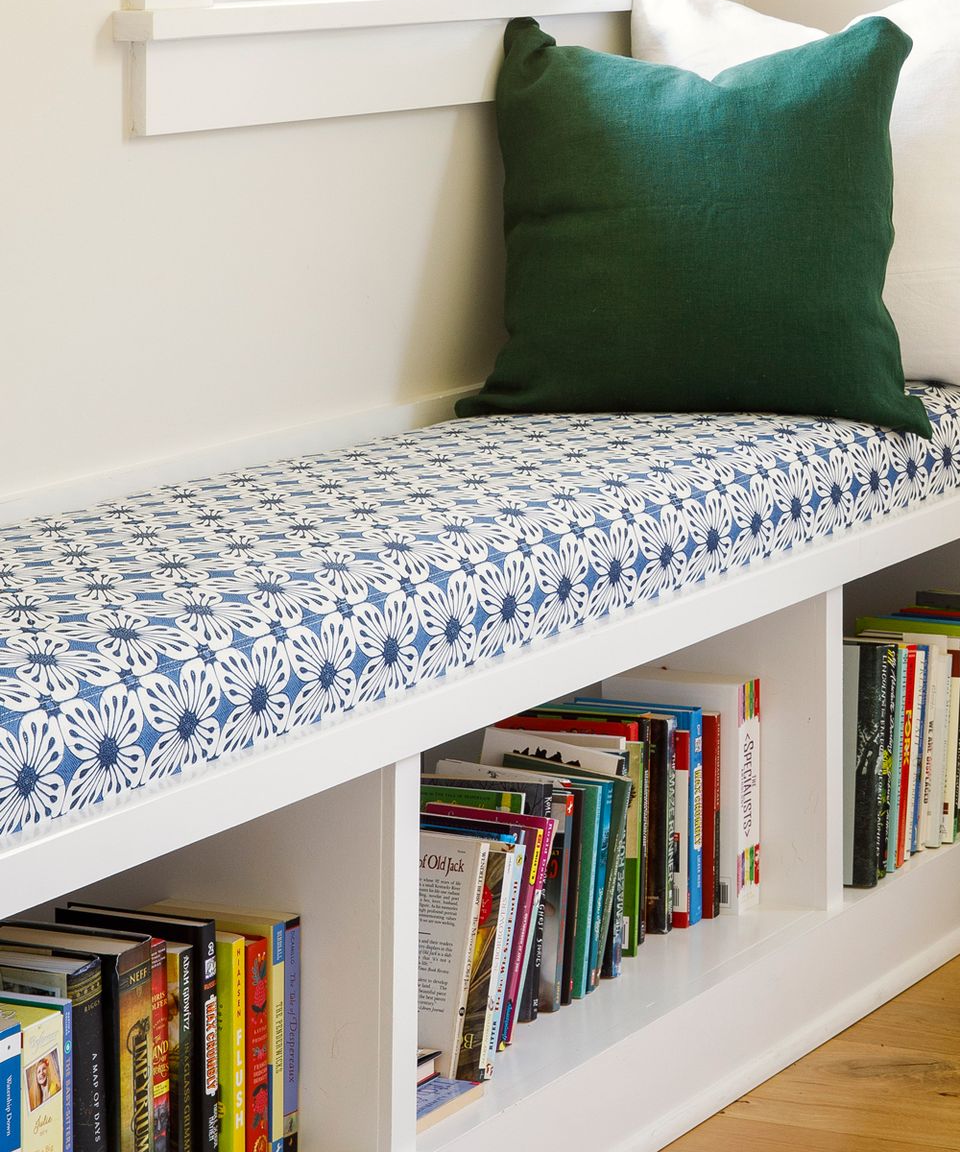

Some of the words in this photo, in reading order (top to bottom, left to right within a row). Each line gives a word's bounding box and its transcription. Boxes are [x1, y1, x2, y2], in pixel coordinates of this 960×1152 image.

[903, 709, 912, 765] FORK
[928, 720, 934, 734] WE
[667, 774, 675, 818] MAZE
[924, 756, 932, 804] DISPLACED
[428, 854, 447, 870] Old
[445, 857, 464, 877] Jack
[477, 851, 487, 884] WENDELL
[474, 885, 482, 905] BERRY
[129, 967, 148, 985] NEFF
[183, 955, 191, 986] ADAM
[289, 972, 297, 989] The
[182, 988, 192, 1032] GIDWITZ
[206, 1003, 215, 1032] MAX
[206, 1034, 216, 1089] CRUMBLY
[275, 1020, 283, 1074] PENDERWICKS
[287, 1017, 297, 1083] Despereaux
[4, 1075, 13, 1112] Watership
[183, 1067, 191, 1103] GLASS
[235, 1029, 244, 1129] FLUSH
[93, 1092, 99, 1108] OF
